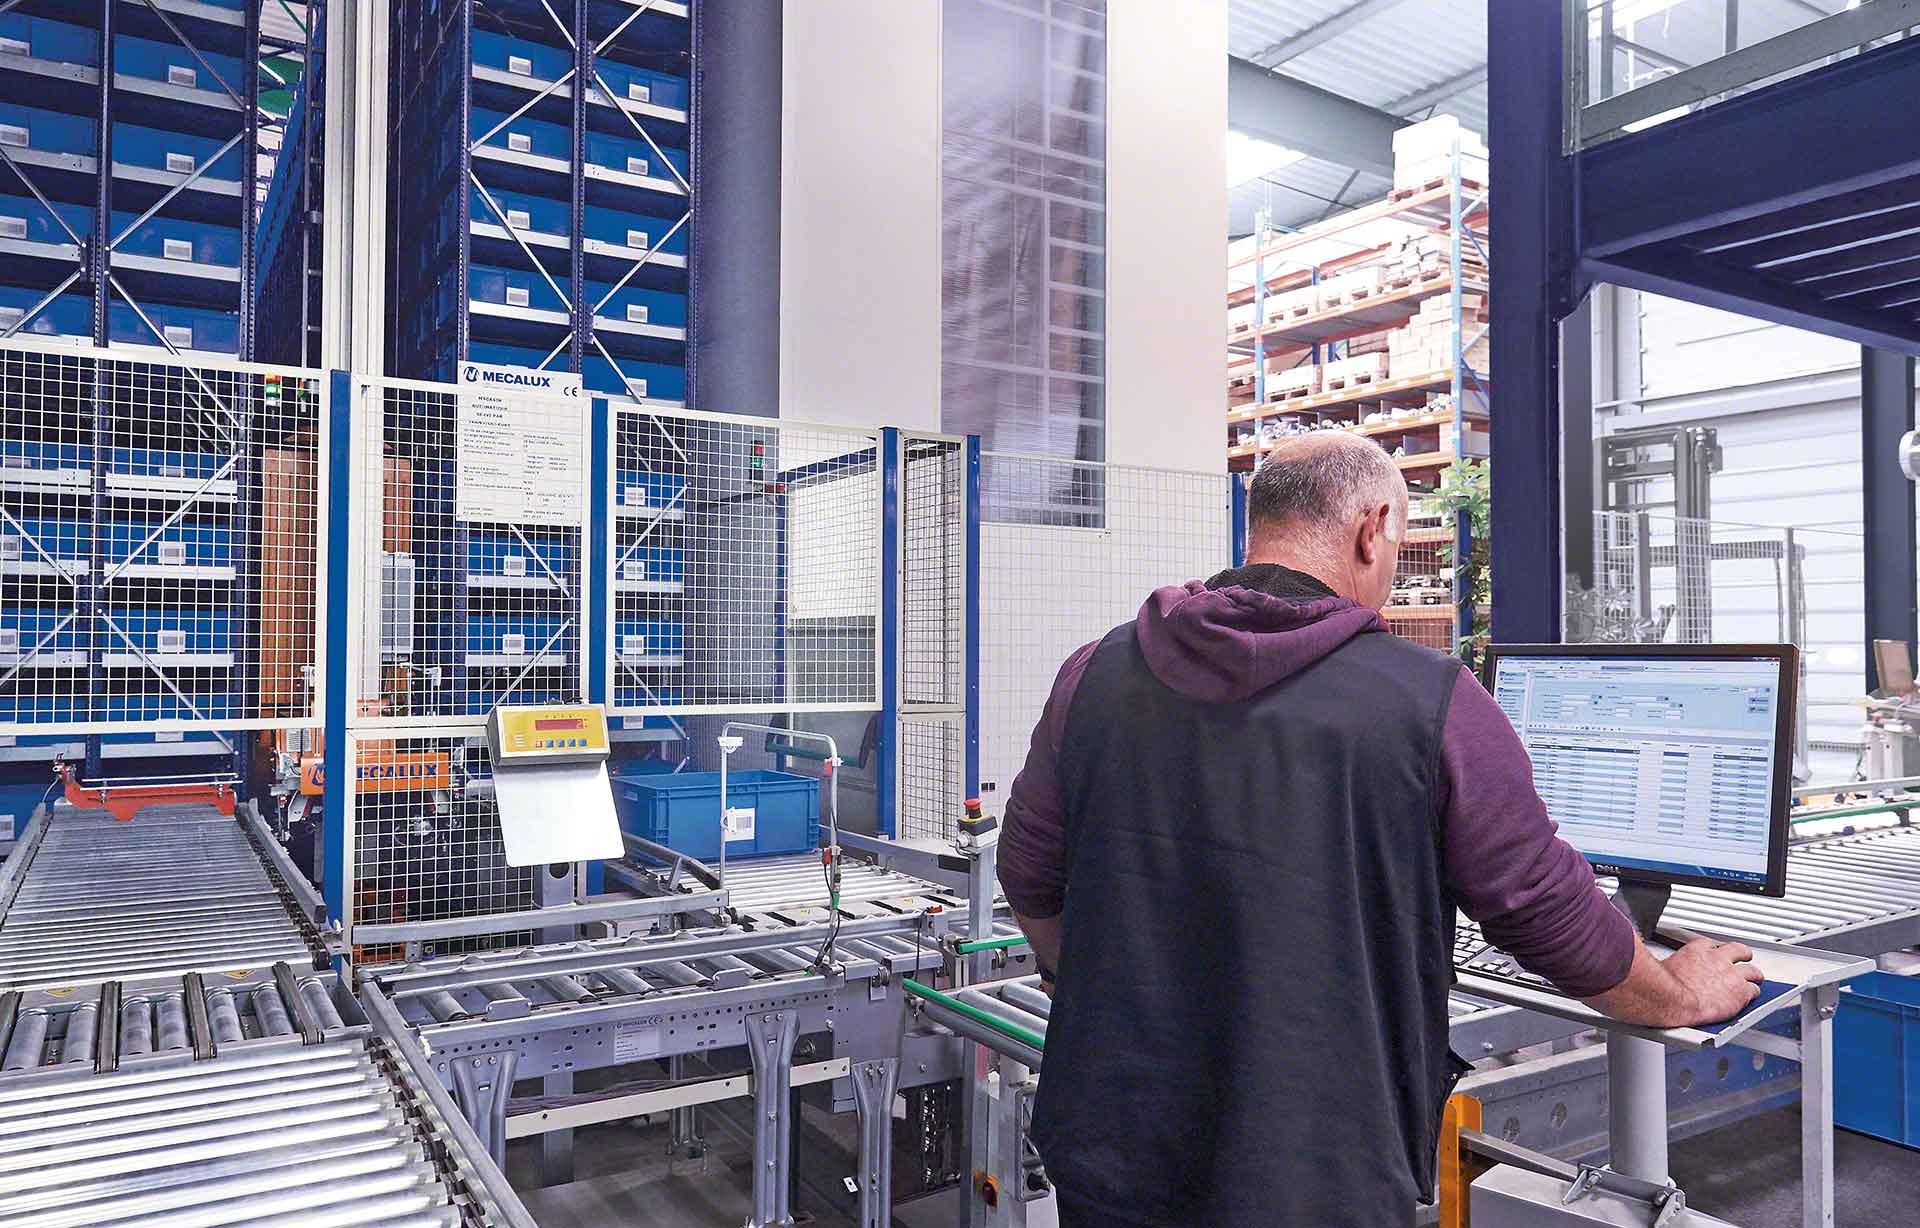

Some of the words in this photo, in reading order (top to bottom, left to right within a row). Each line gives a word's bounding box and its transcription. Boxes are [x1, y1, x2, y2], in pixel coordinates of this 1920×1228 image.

[483, 371, 551, 387] MECALUX
[356, 764, 438, 778] ECALUX
[1596, 864, 1621, 874] DELL
